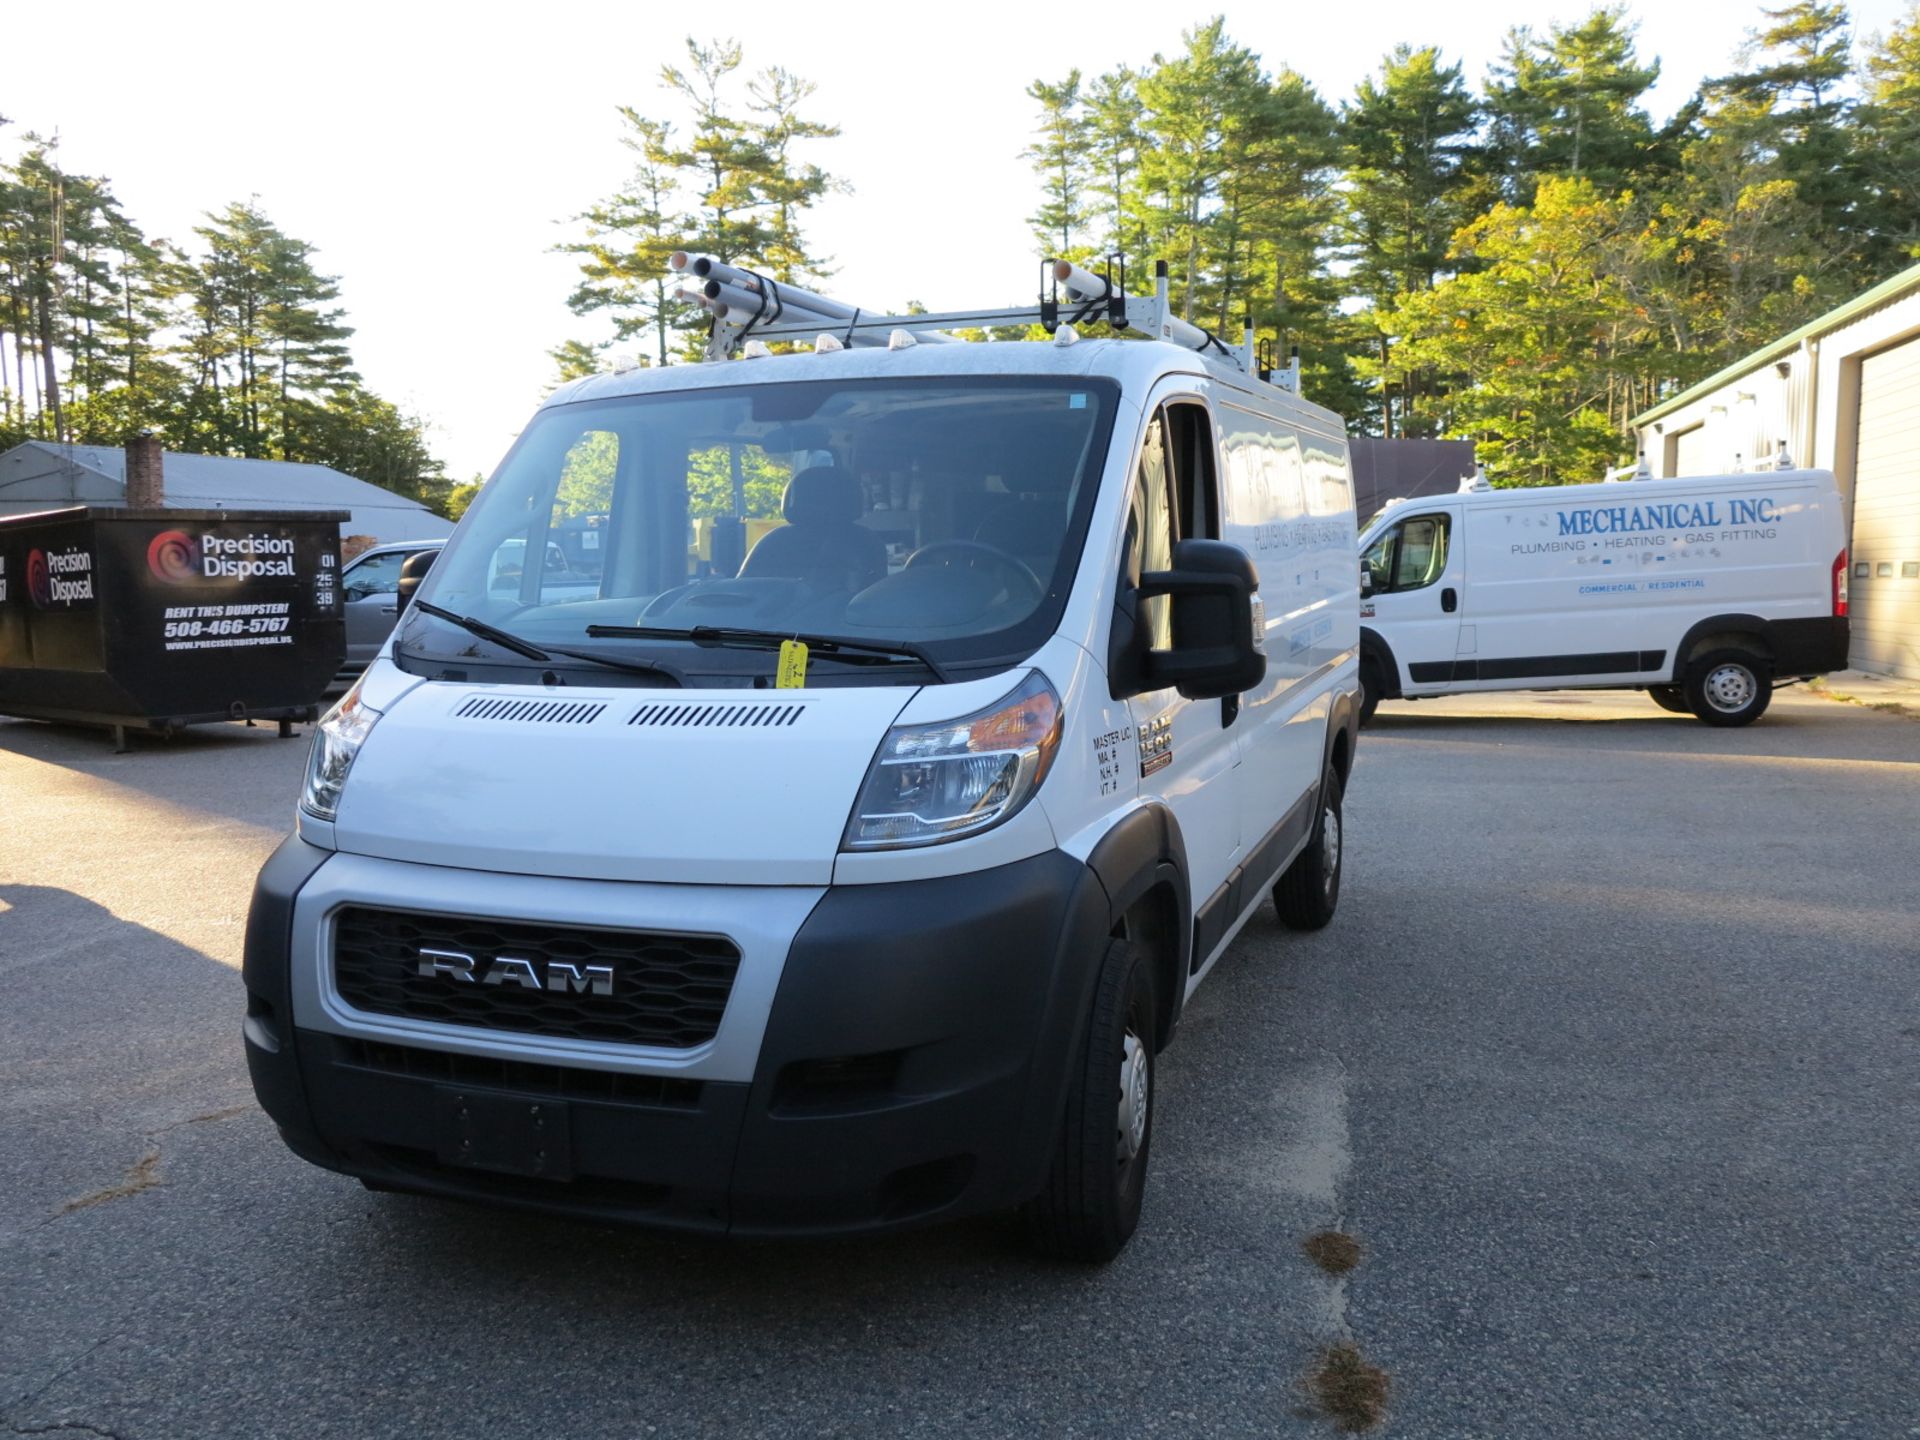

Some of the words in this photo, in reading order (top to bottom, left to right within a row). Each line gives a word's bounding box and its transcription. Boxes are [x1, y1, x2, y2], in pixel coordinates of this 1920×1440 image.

[1557, 501, 1721, 536] MECHANICAL
[1728, 498, 1781, 525] INC.
[202, 533, 295, 554] Precision
[1511, 540, 1586, 555] PLUMBING
[1604, 535, 1666, 549] HEATING
[1685, 532, 1715, 544] GAS
[1721, 528, 1777, 541] FITTING
[47, 547, 91, 574] Precision
[203, 555, 296, 582] Disposal
[50, 573, 94, 607] Disposal
[1578, 583, 1637, 594] COMMERCIAL
[1648, 580, 1705, 590] RESIDENTIAL
[164, 606, 196, 619] RENT
[197, 605, 224, 617] THIS
[225, 602, 290, 616] DUMPSTER!
[164, 617, 290, 638] 508-466-5767
[1093, 730, 1120, 750] MASTER
[418, 948, 614, 996] RAM
